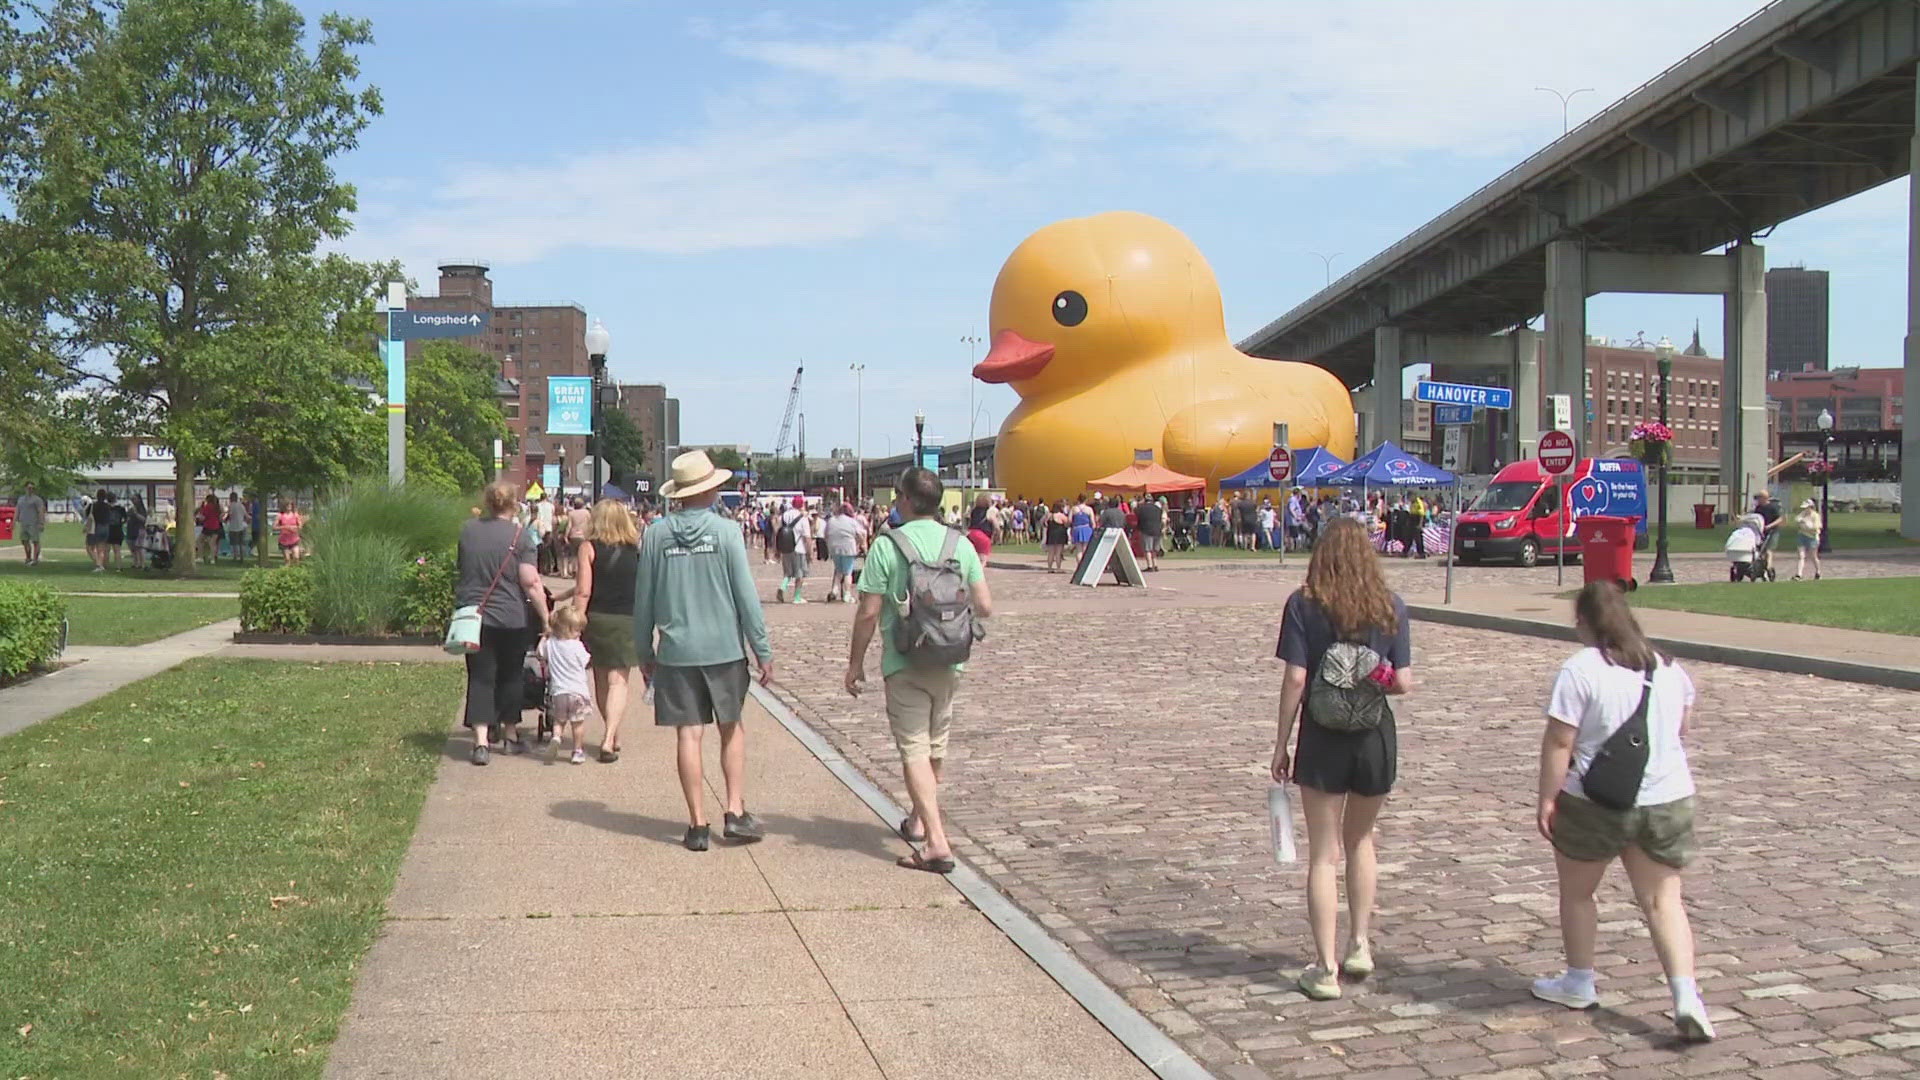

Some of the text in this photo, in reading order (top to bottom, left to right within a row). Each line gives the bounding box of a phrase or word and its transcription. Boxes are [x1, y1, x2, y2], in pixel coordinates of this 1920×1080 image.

[413, 314, 467, 326] Longshed
[554, 385, 585, 395] GREAT
[1427, 384, 1500, 404] HANOVER ST
[556, 395, 584, 404] LAWN
[1557, 397, 1568, 406] ONE
[1440, 407, 1460, 421] PRIME
[1446, 429, 1458, 441] ONE
[1446, 443, 1458, 453] WAY
[1543, 439, 1568, 447] DO NOT
[1546, 458, 1567, 466] ENTER
[636, 480, 650, 492] 703
[1610, 482, 1617, 490] Be
[1617, 482, 1625, 490] the
[1617, 492, 1628, 500] your
